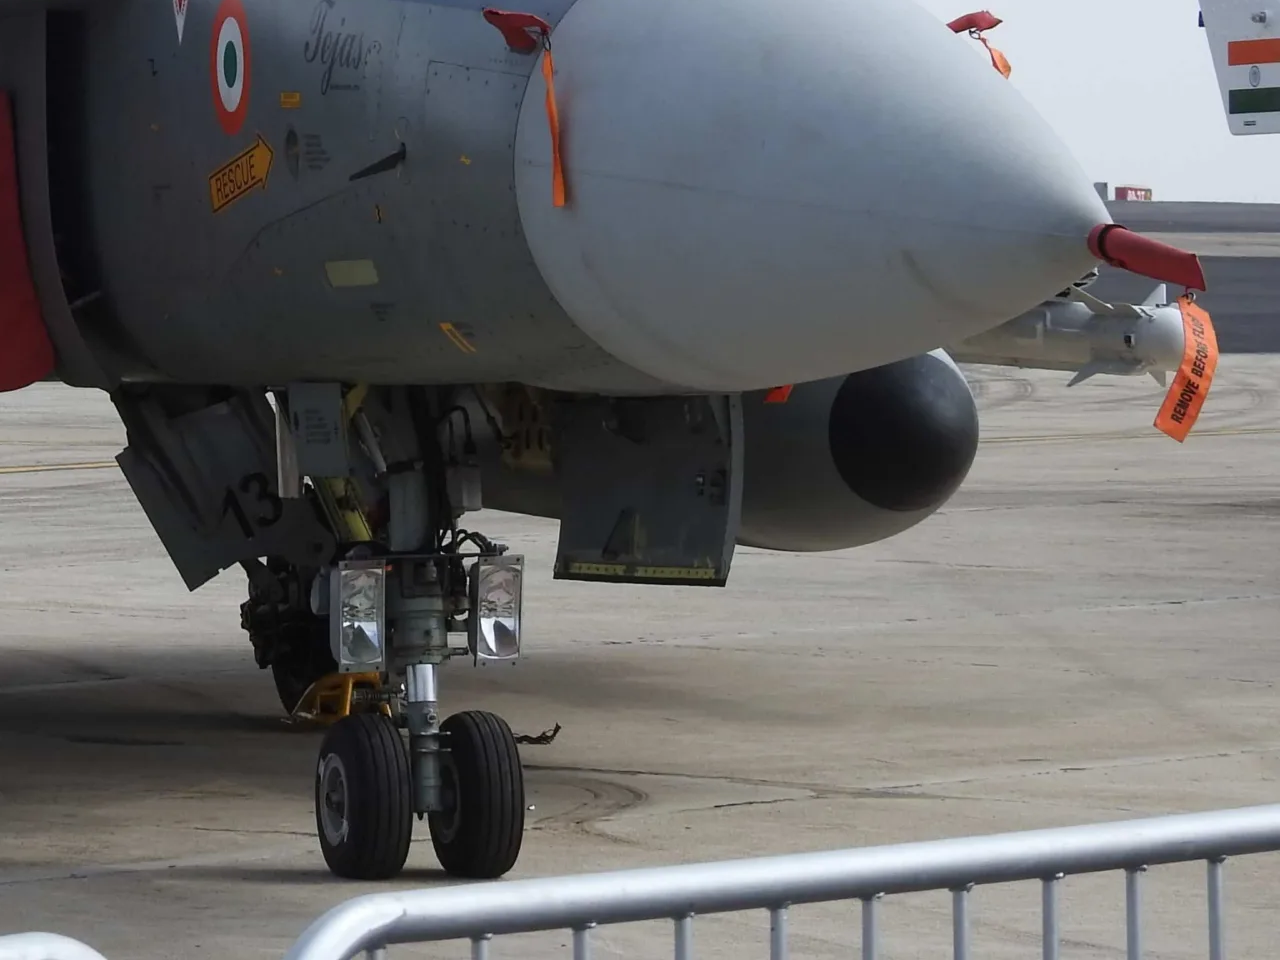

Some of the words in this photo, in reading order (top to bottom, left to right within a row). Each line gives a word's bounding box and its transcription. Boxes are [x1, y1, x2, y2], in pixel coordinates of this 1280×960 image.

[215, 153, 256, 204] RESCUE
[1171, 379, 1200, 424] REMOVE
[222, 472, 283, 538] 13
